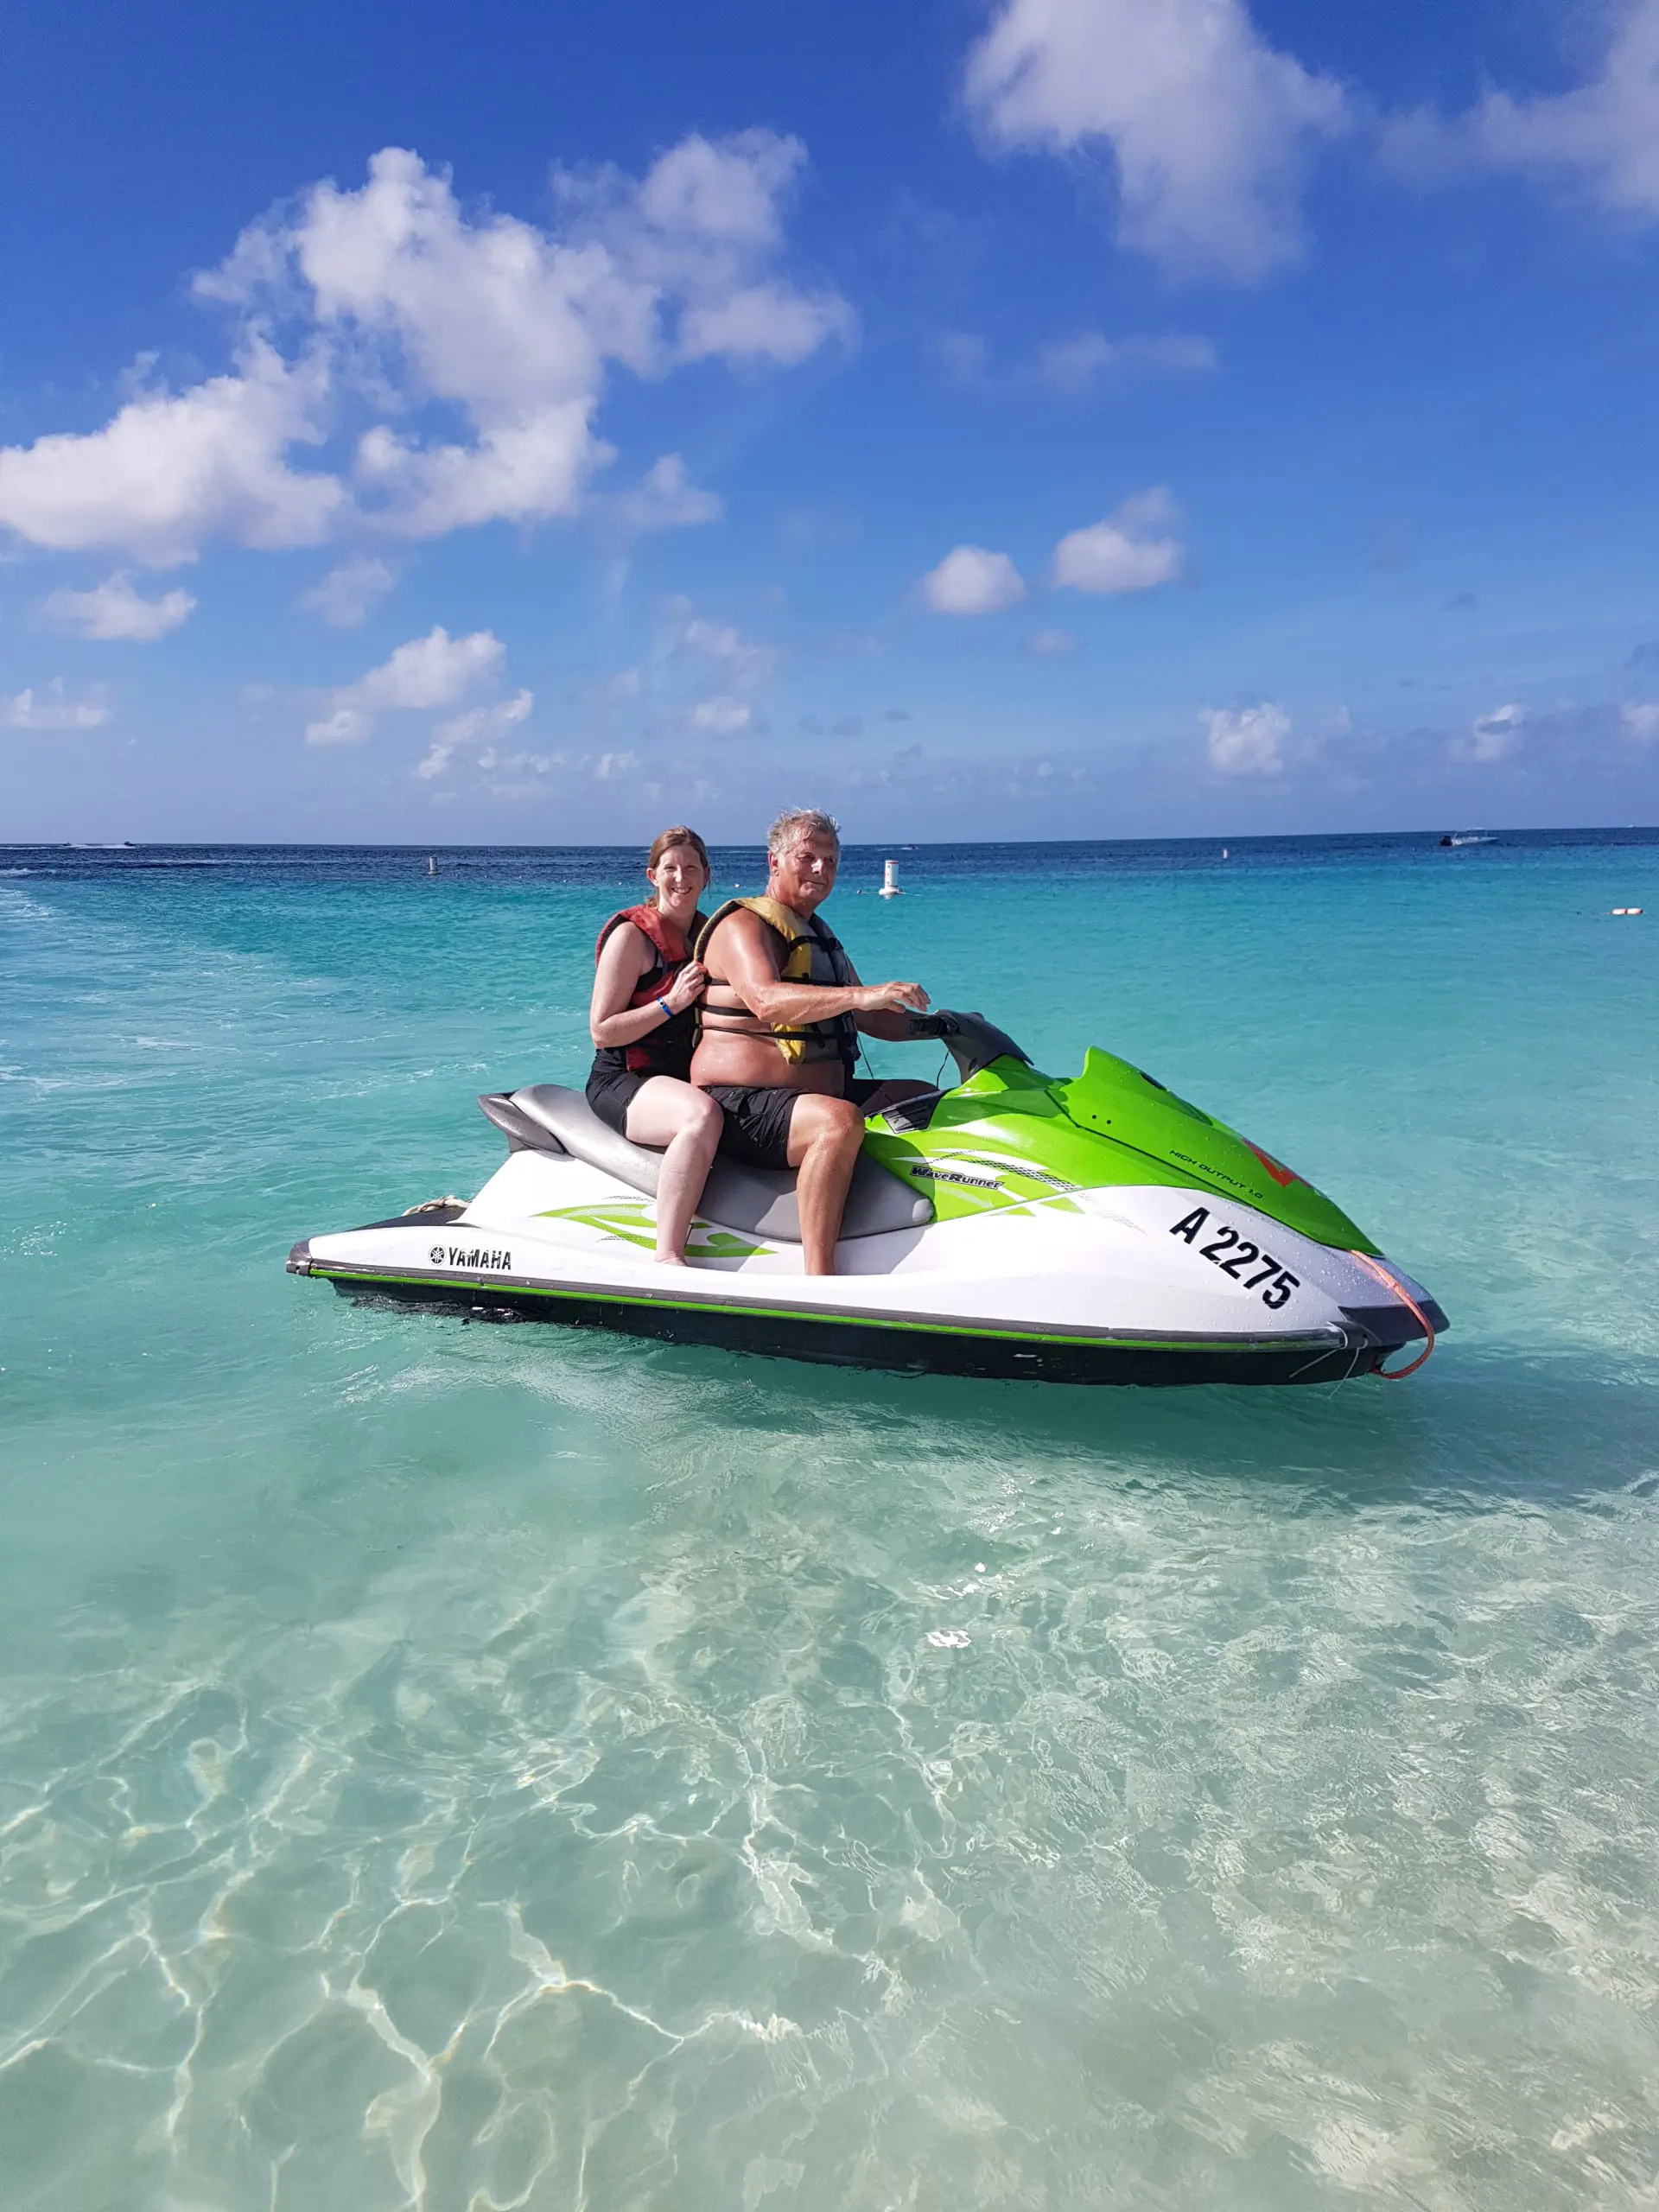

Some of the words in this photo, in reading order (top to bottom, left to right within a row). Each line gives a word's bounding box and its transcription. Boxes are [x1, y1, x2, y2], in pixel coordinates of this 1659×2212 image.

[911, 1166, 1004, 1190] WaveRunner
[1169, 1150, 1198, 1165] HIGH
[1198, 1164, 1247, 1188] OUTPUT
[1248, 1188, 1263, 1198] 1.0
[448, 1247, 512, 1270] YAMAHA
[1169, 1207, 1211, 1244] A
[1199, 1226, 1300, 1309] 2275
